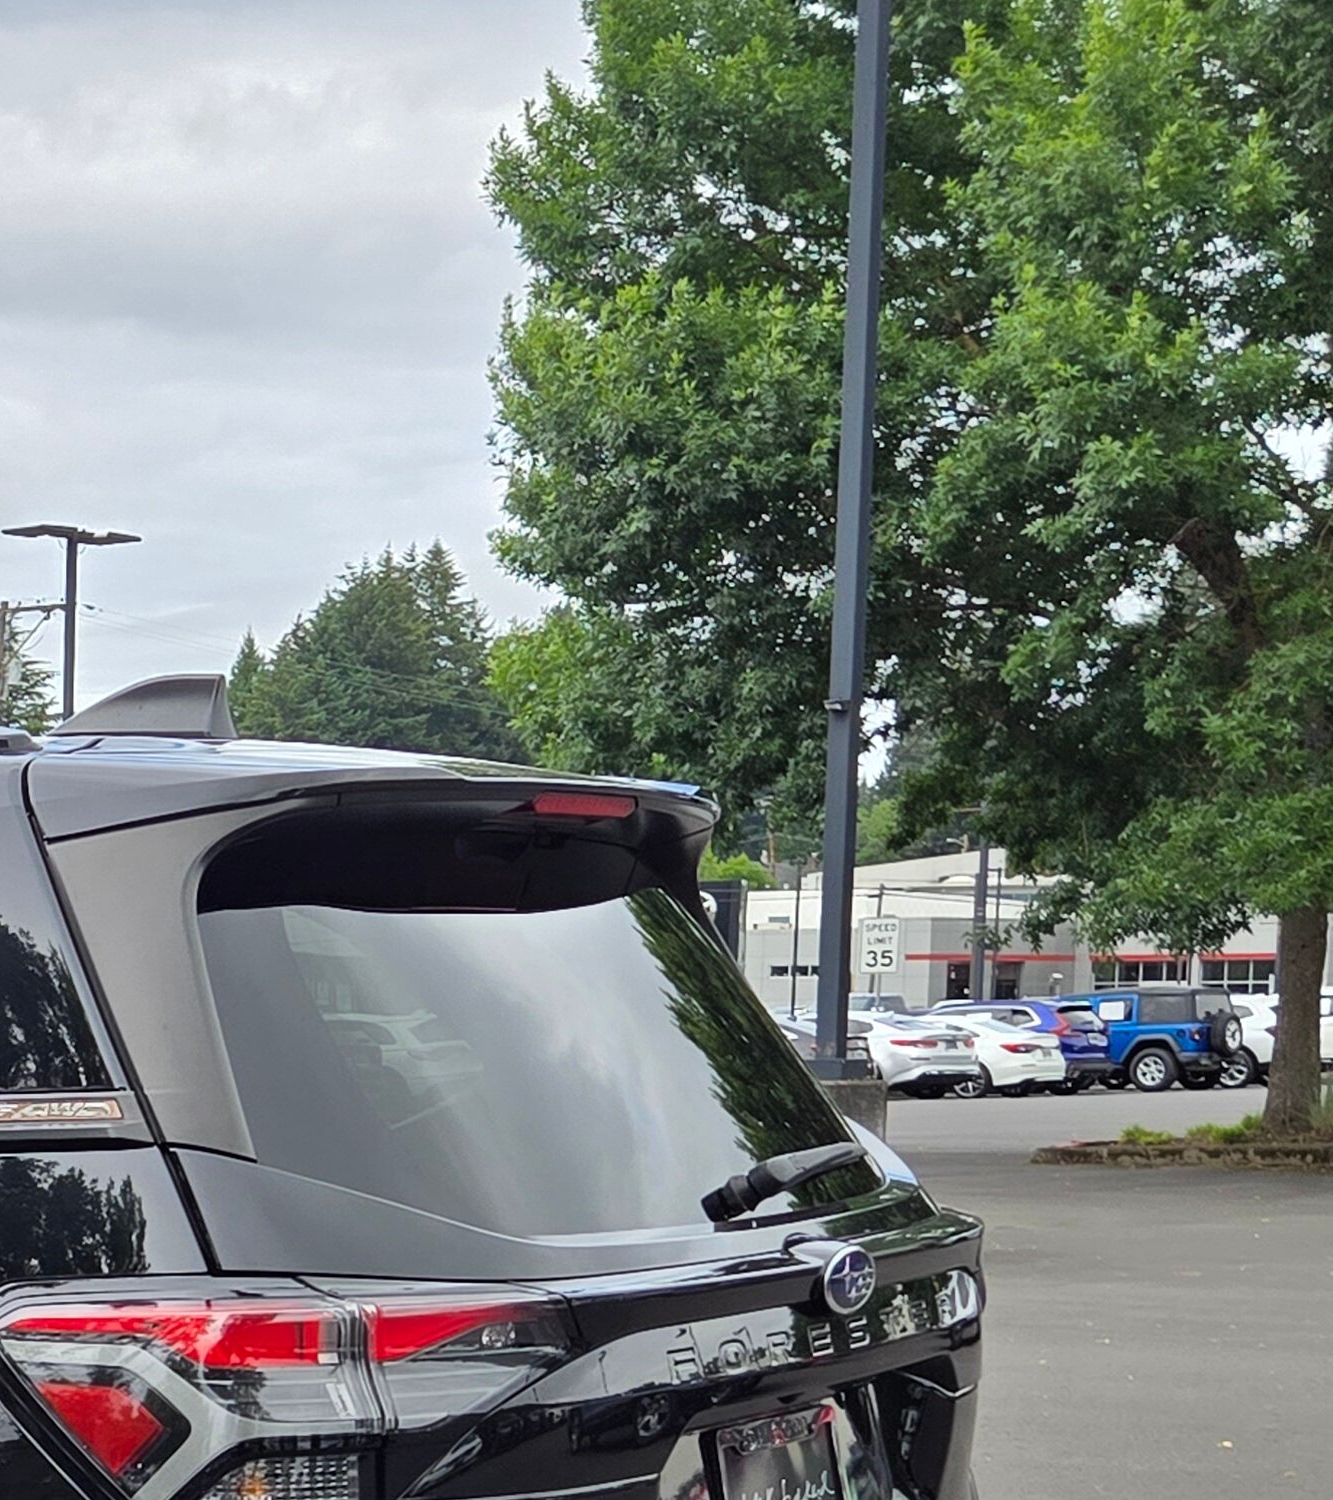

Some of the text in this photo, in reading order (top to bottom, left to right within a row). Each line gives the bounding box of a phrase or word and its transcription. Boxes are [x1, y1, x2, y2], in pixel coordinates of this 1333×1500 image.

[865, 923, 897, 932] SPEED
[867, 936, 893, 945] LIMIT
[865, 950, 893, 968] 35
[666, 1291, 957, 1382] FORESTER
